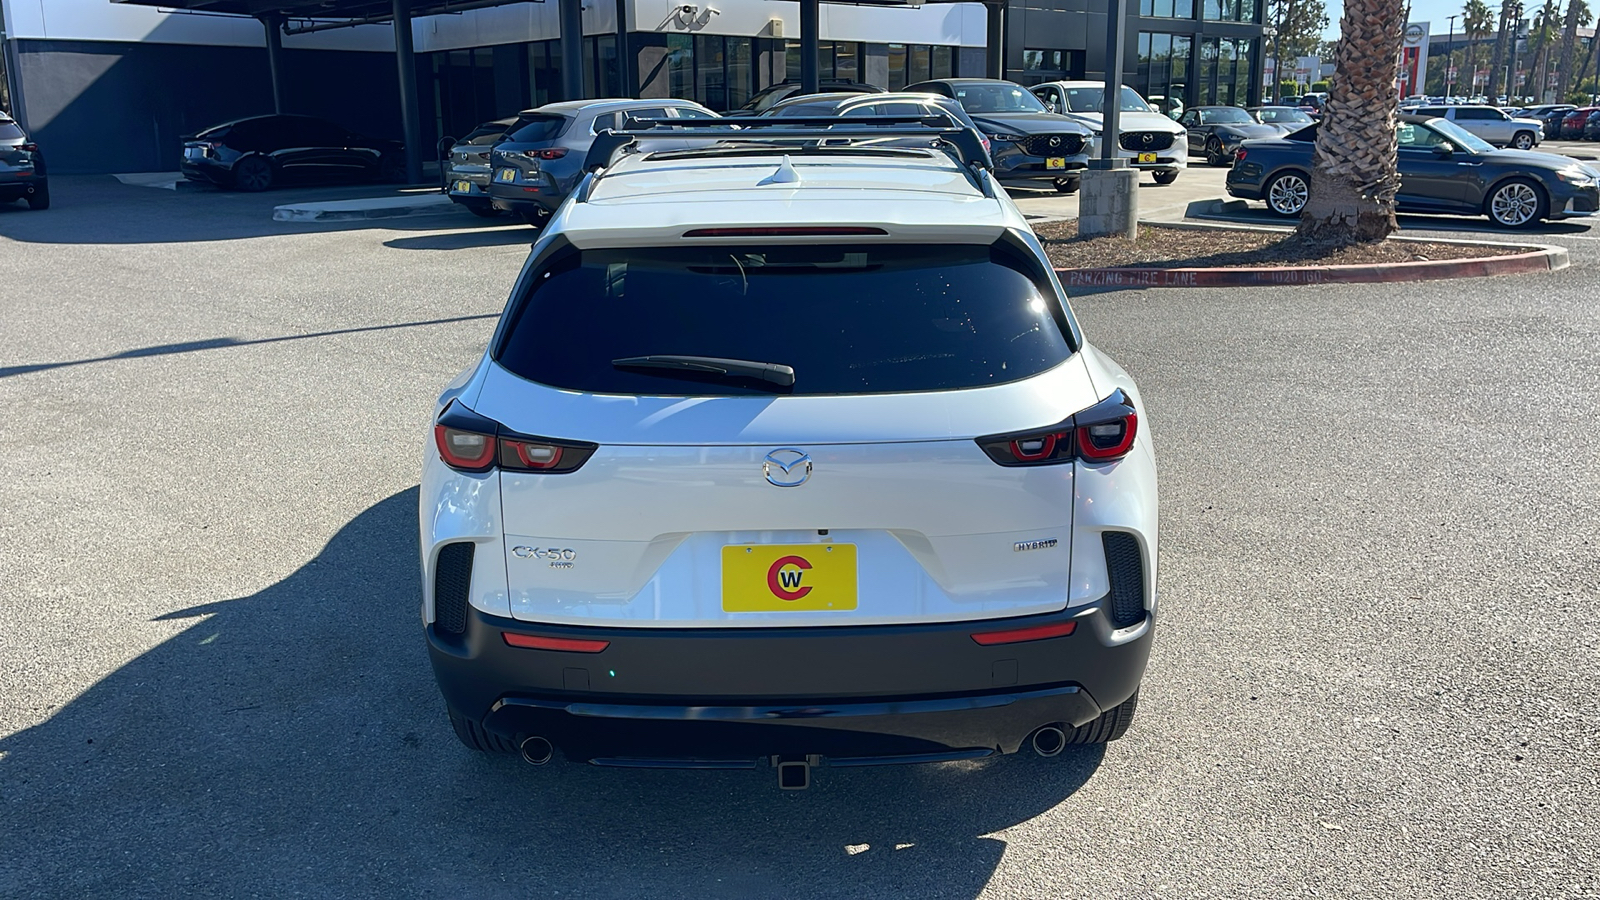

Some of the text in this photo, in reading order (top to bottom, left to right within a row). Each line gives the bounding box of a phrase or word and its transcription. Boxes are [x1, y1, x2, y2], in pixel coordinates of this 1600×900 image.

[1129, 271, 1158, 285] FIRE
[1165, 272, 1197, 285] LANE
[1018, 539, 1056, 550] HYBRID
[512, 545, 577, 561] CX-50
